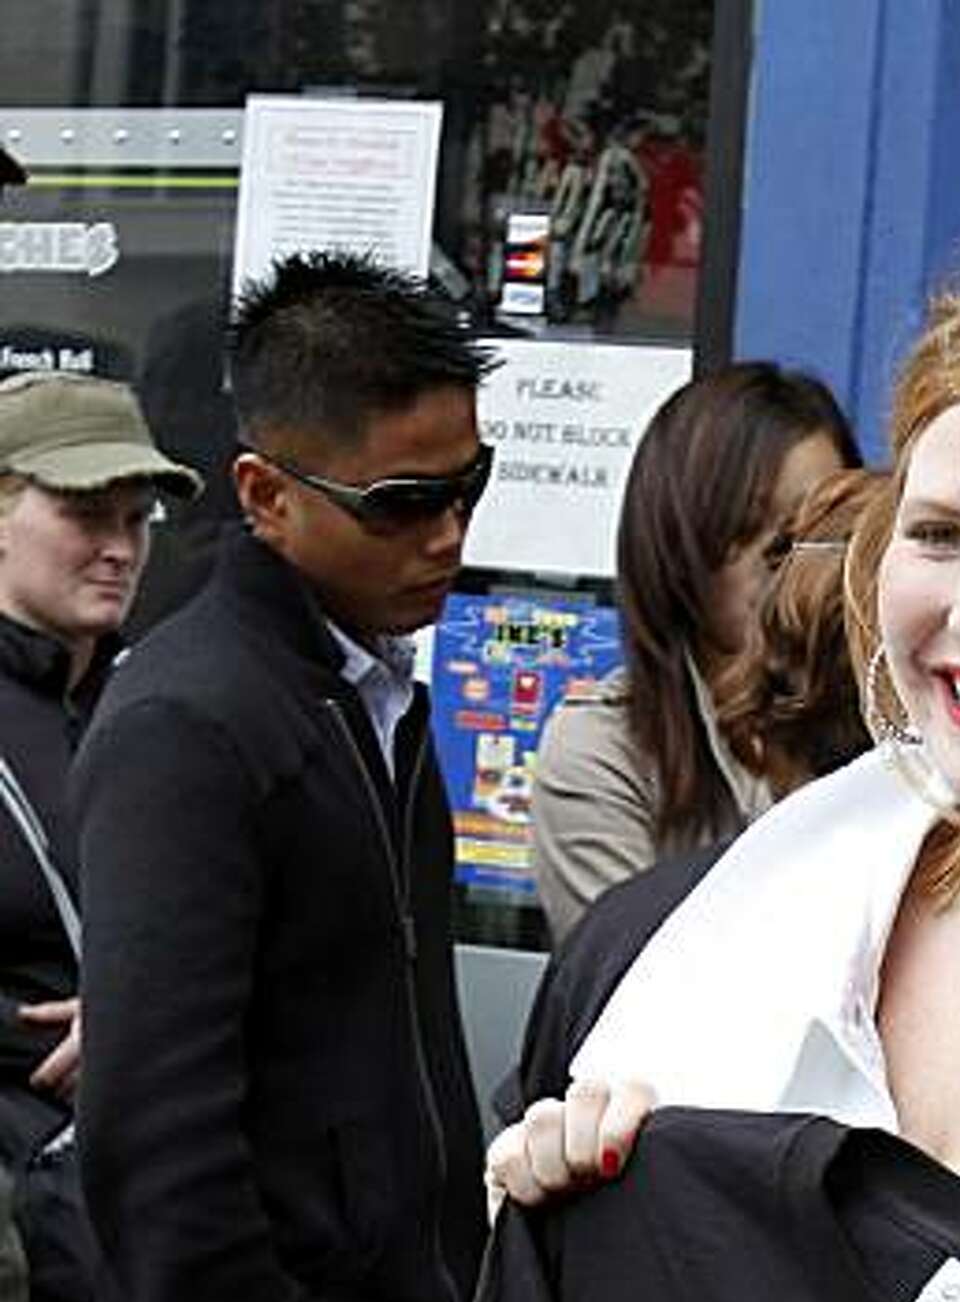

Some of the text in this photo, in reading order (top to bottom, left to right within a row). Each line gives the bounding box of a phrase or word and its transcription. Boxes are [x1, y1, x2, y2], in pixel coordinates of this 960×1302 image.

[513, 421, 557, 444] NOT
[561, 424, 631, 447] BLOCK
[499, 461, 608, 487] SIDEWALK
